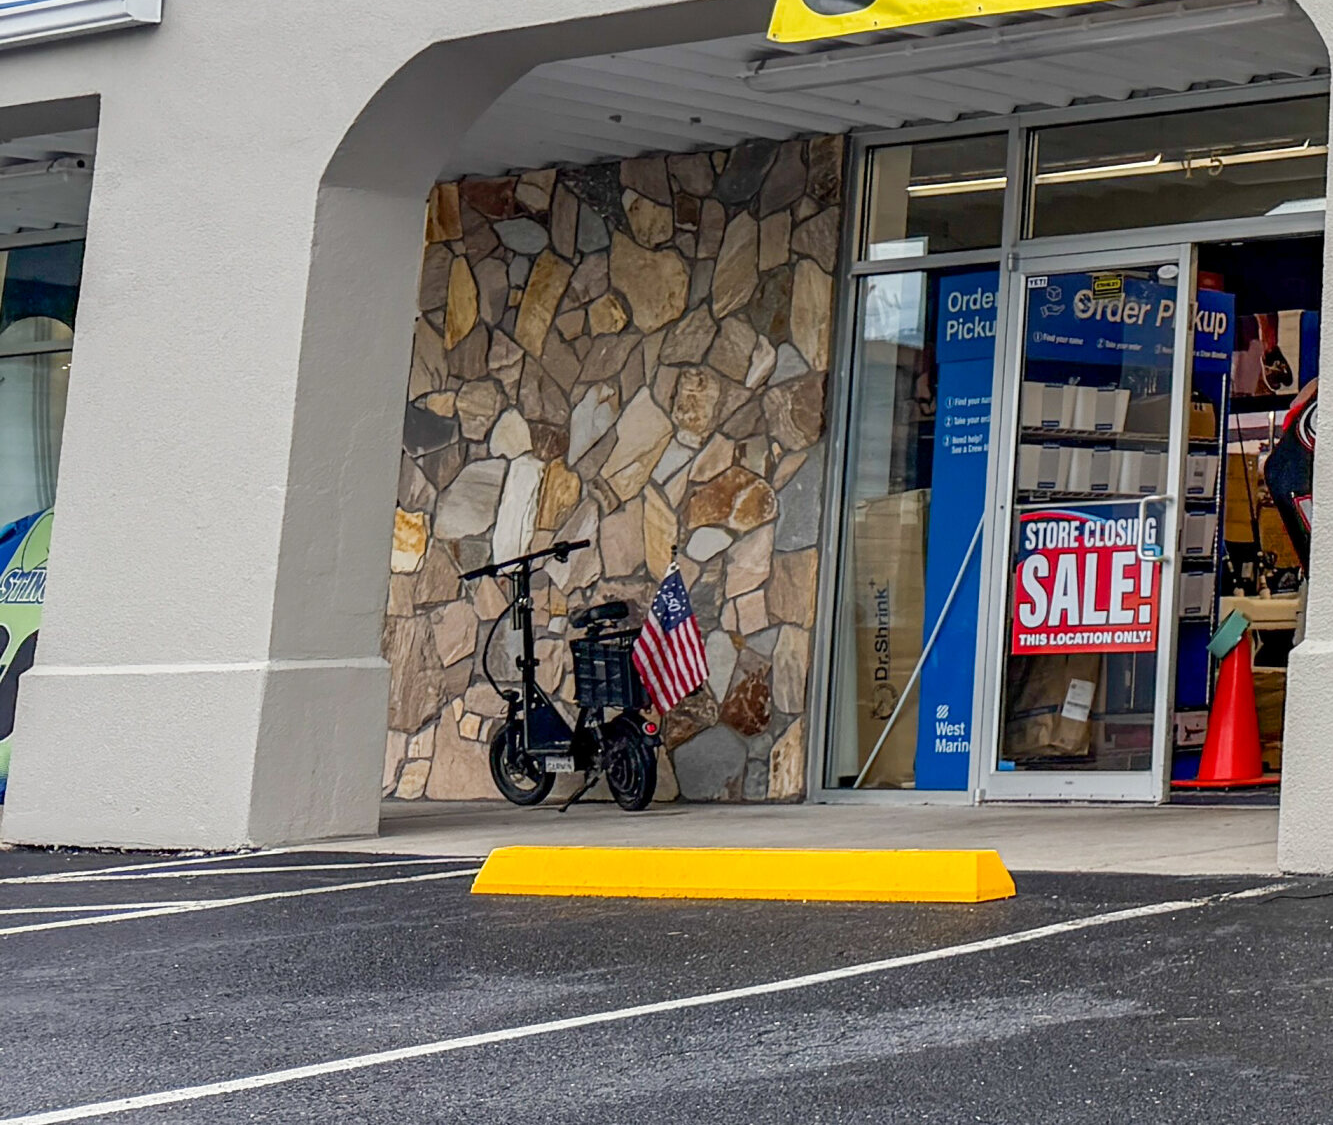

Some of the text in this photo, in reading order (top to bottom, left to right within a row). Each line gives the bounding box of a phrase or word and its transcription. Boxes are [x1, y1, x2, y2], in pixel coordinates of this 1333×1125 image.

[946, 316, 997, 342] Picku
[1073, 289, 1227, 341] Order Pkup
[1025, 520, 1079, 551] STORE
[0, 567, 47, 604] STIN
[1018, 550, 1154, 629] SALE!
[662, 590, 681, 613] 250
[1018, 629, 1152, 646] THIS LOCATION ONLY!
[935, 722, 971, 754] West Marin
